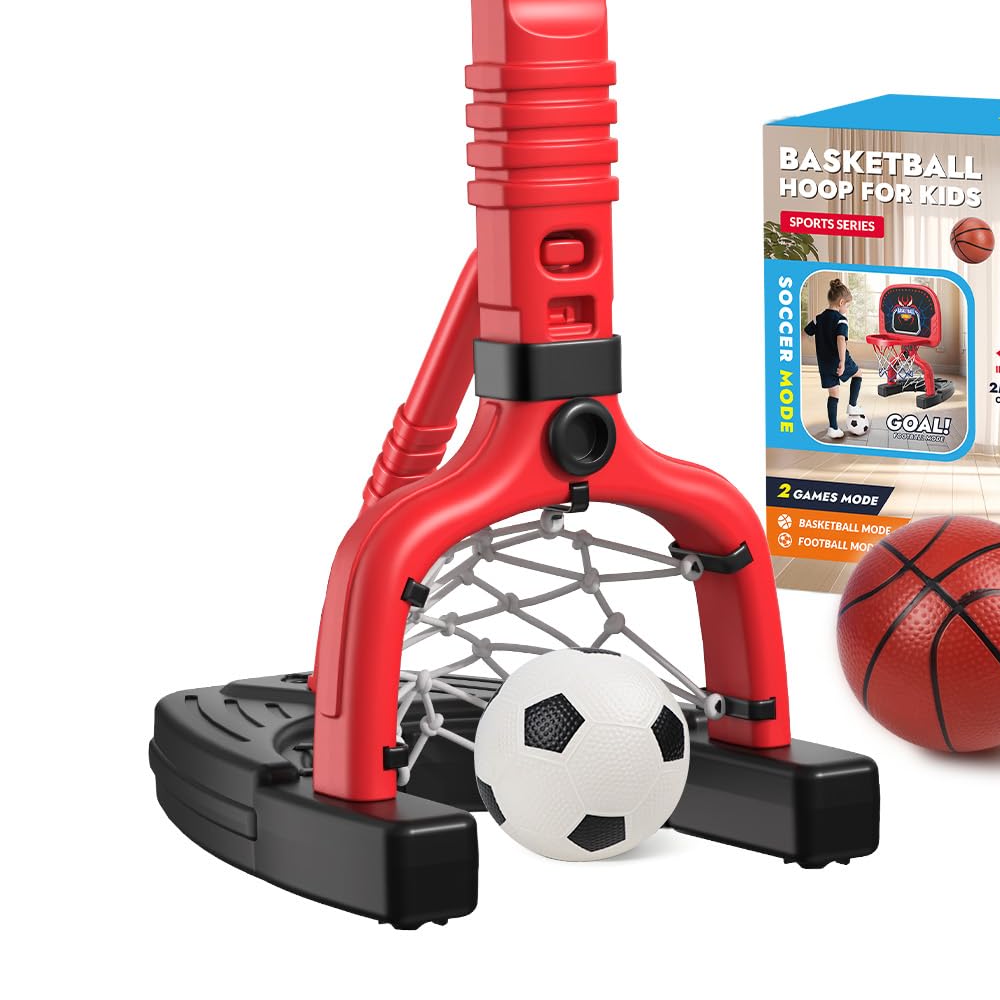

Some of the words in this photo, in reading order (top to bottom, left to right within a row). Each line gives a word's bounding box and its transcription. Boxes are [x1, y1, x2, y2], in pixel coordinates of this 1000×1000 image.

[779, 146, 983, 181] BASKETBALL
[779, 177, 854, 200] HOOP
[861, 181, 913, 205] FOR
[919, 184, 983, 209] KIDS
[789, 216, 835, 229] SPORTS
[837, 218, 875, 231] SERIES
[778, 275, 794, 362] SOCCER
[779, 369, 794, 433] MODE
[886, 412, 953, 436] GOAL!
[777, 483, 792, 499] 2
[793, 489, 838, 503] GAMES
[840, 493, 879, 506] MODE
[799, 518, 860, 533] BASKETBALL
[861, 524, 892, 535] MODE
[798, 536, 848, 550] FOOTBALL
[850, 542, 874, 552] MOD
